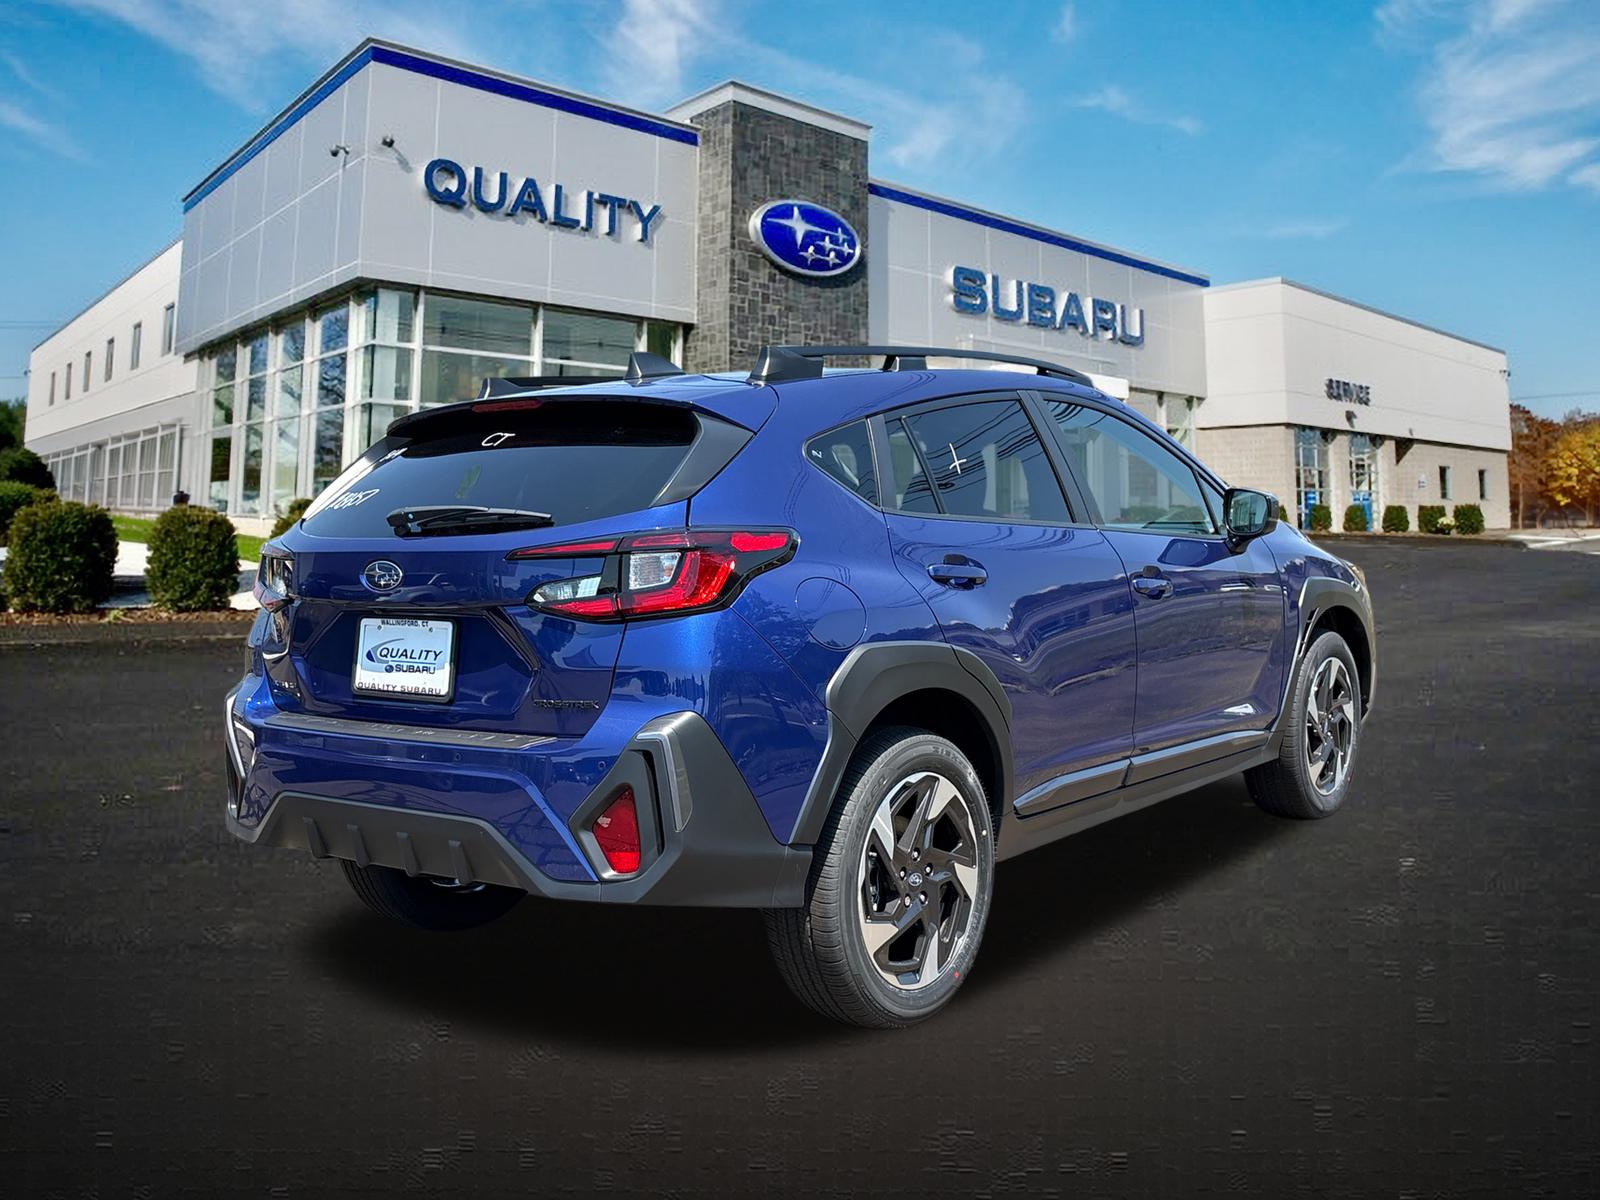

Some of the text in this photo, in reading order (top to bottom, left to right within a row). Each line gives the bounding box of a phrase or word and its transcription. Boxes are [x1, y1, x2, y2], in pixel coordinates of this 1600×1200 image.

[424, 158, 661, 243] QUALITY
[951, 265, 1144, 347] SUBARU
[379, 647, 443, 661] QUALITY
[394, 664, 436, 675] SUBARU
[357, 682, 441, 695] QUALITY SUBARU
[533, 699, 600, 710] CROSSTREK
